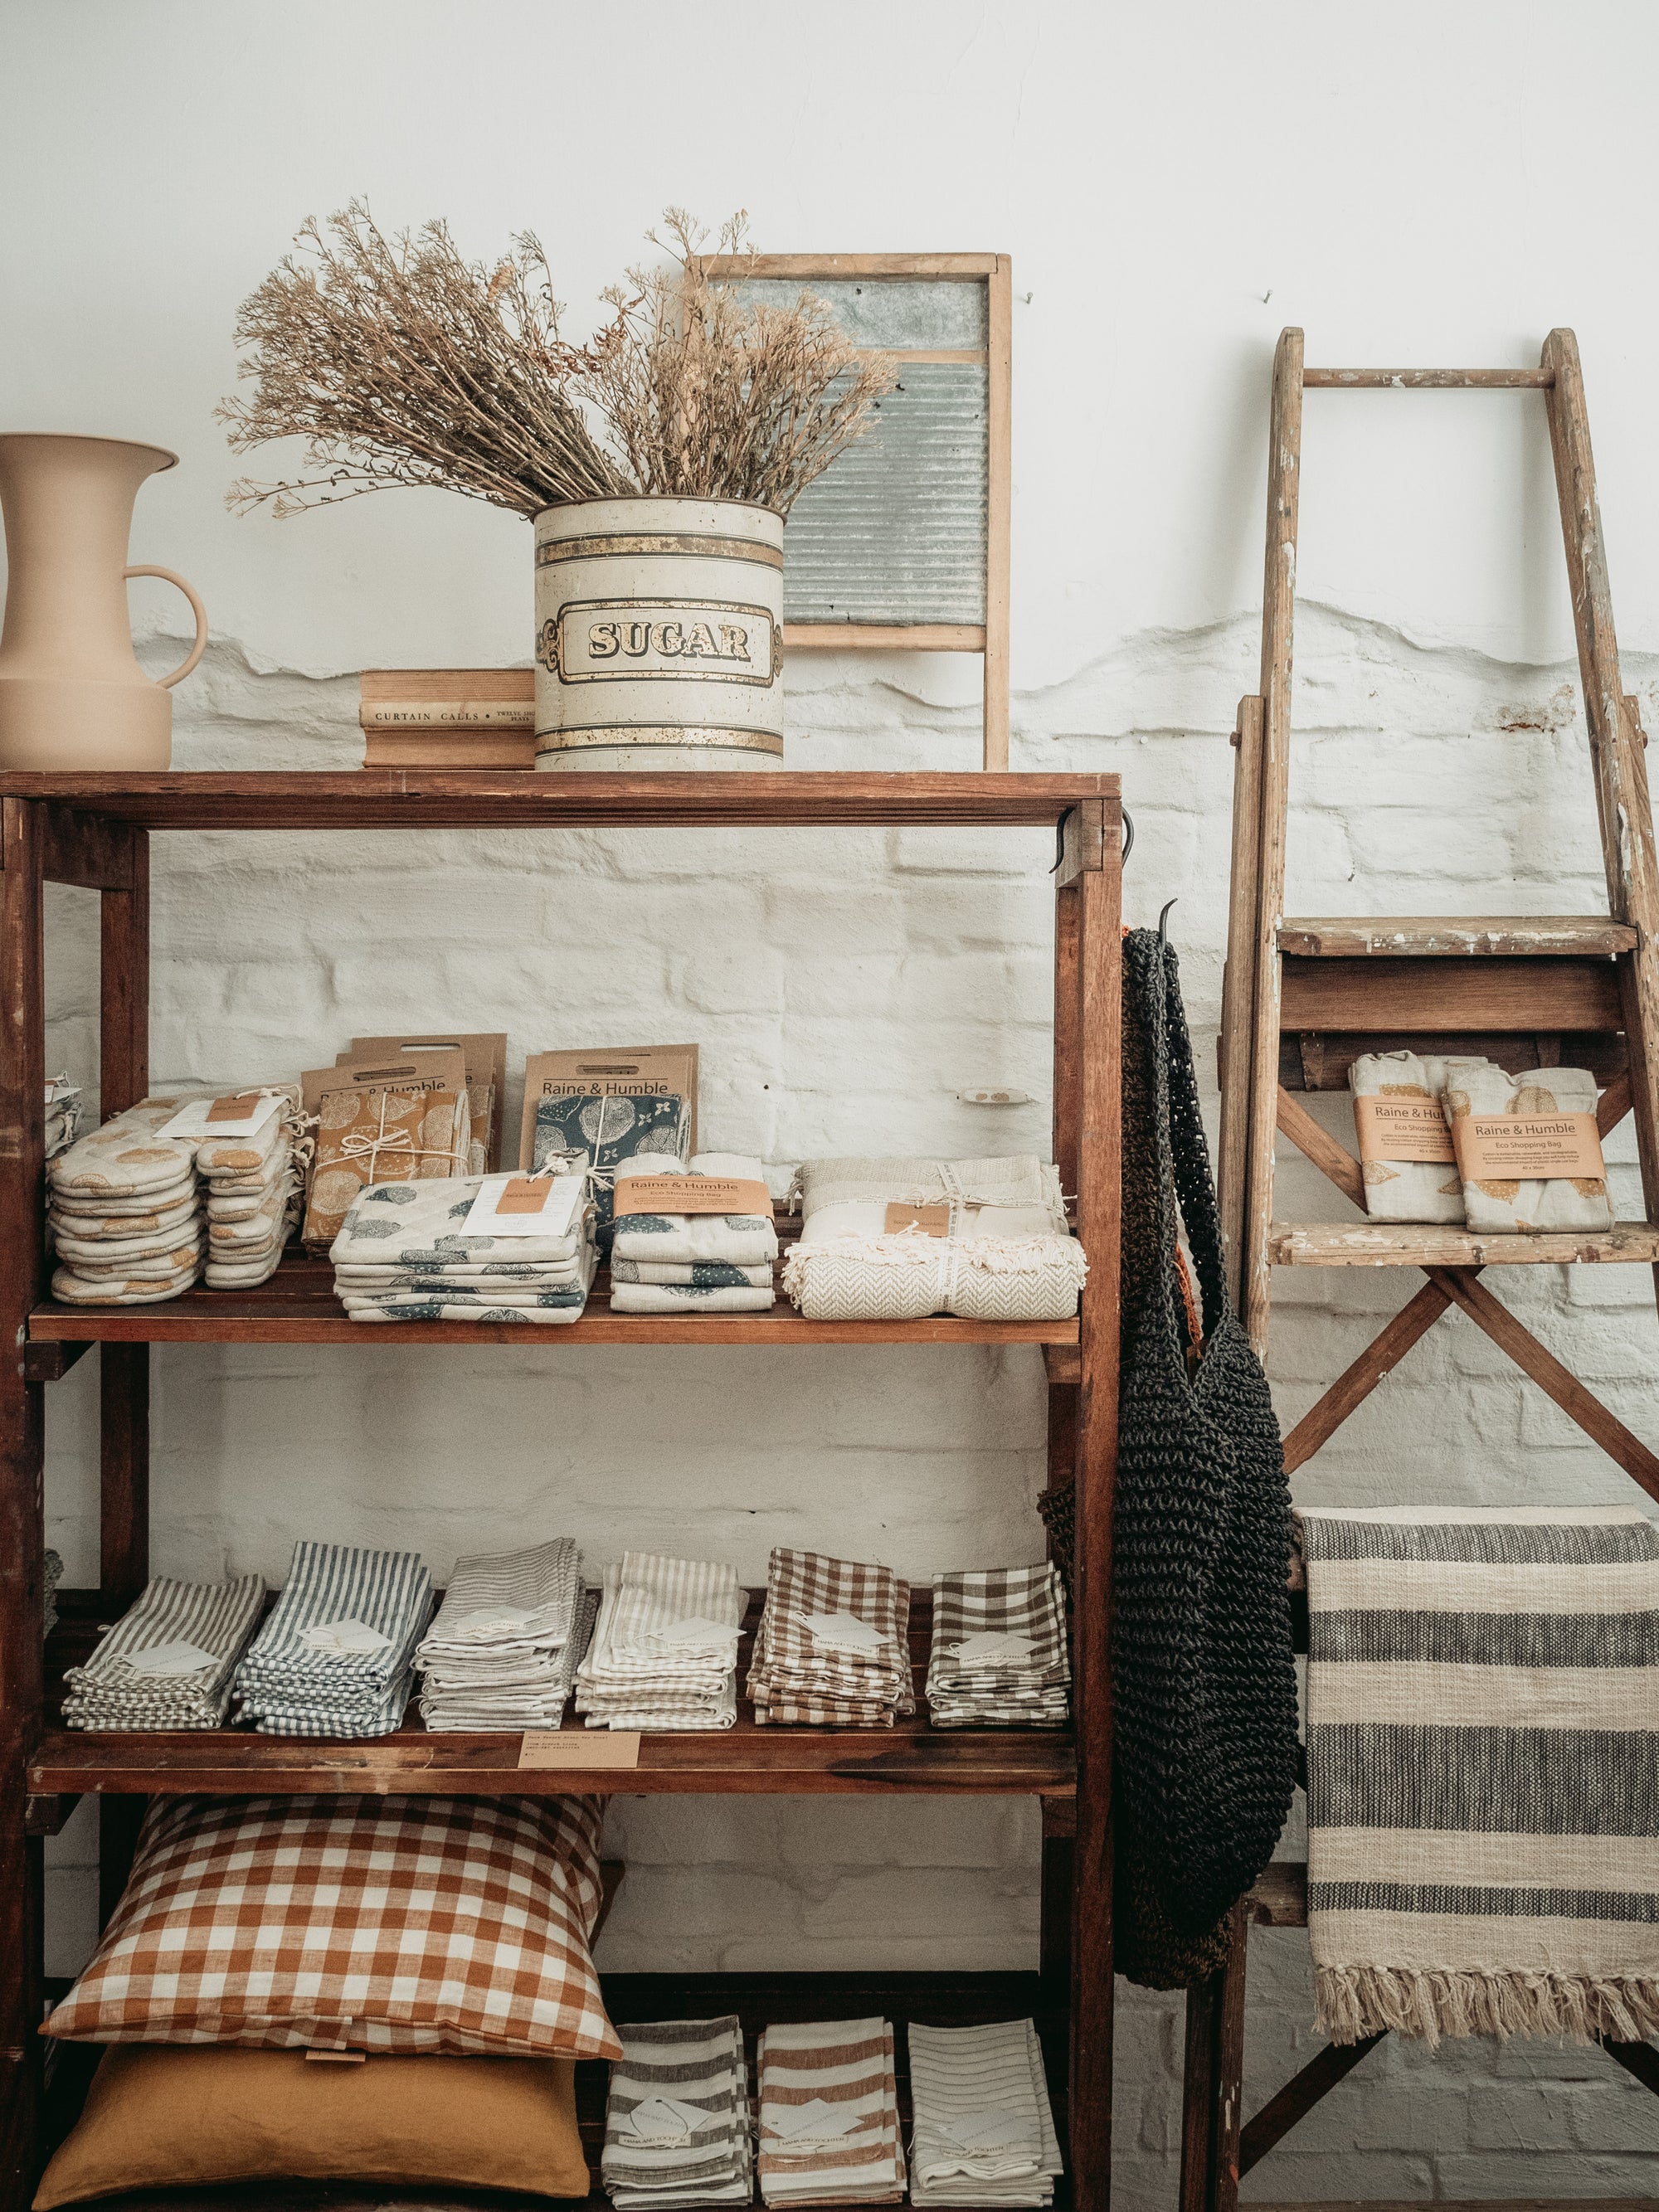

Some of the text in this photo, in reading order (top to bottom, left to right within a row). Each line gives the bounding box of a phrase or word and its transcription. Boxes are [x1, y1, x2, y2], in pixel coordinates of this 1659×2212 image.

[588, 621, 752, 662] SUGAR
[375, 712, 479, 721] CURTAIN CALLS
[542, 1082, 668, 1095] Raine & Humble
[1375, 1106, 1408, 1117] Raine
[1412, 1108, 1421, 1118] &
[1408, 1125, 1443, 1133] Shopping
[1475, 1123, 1575, 1135] Raine & Humble
[1510, 1141, 1546, 1150] Shopping
[1547, 1140, 1562, 1149] Bag
